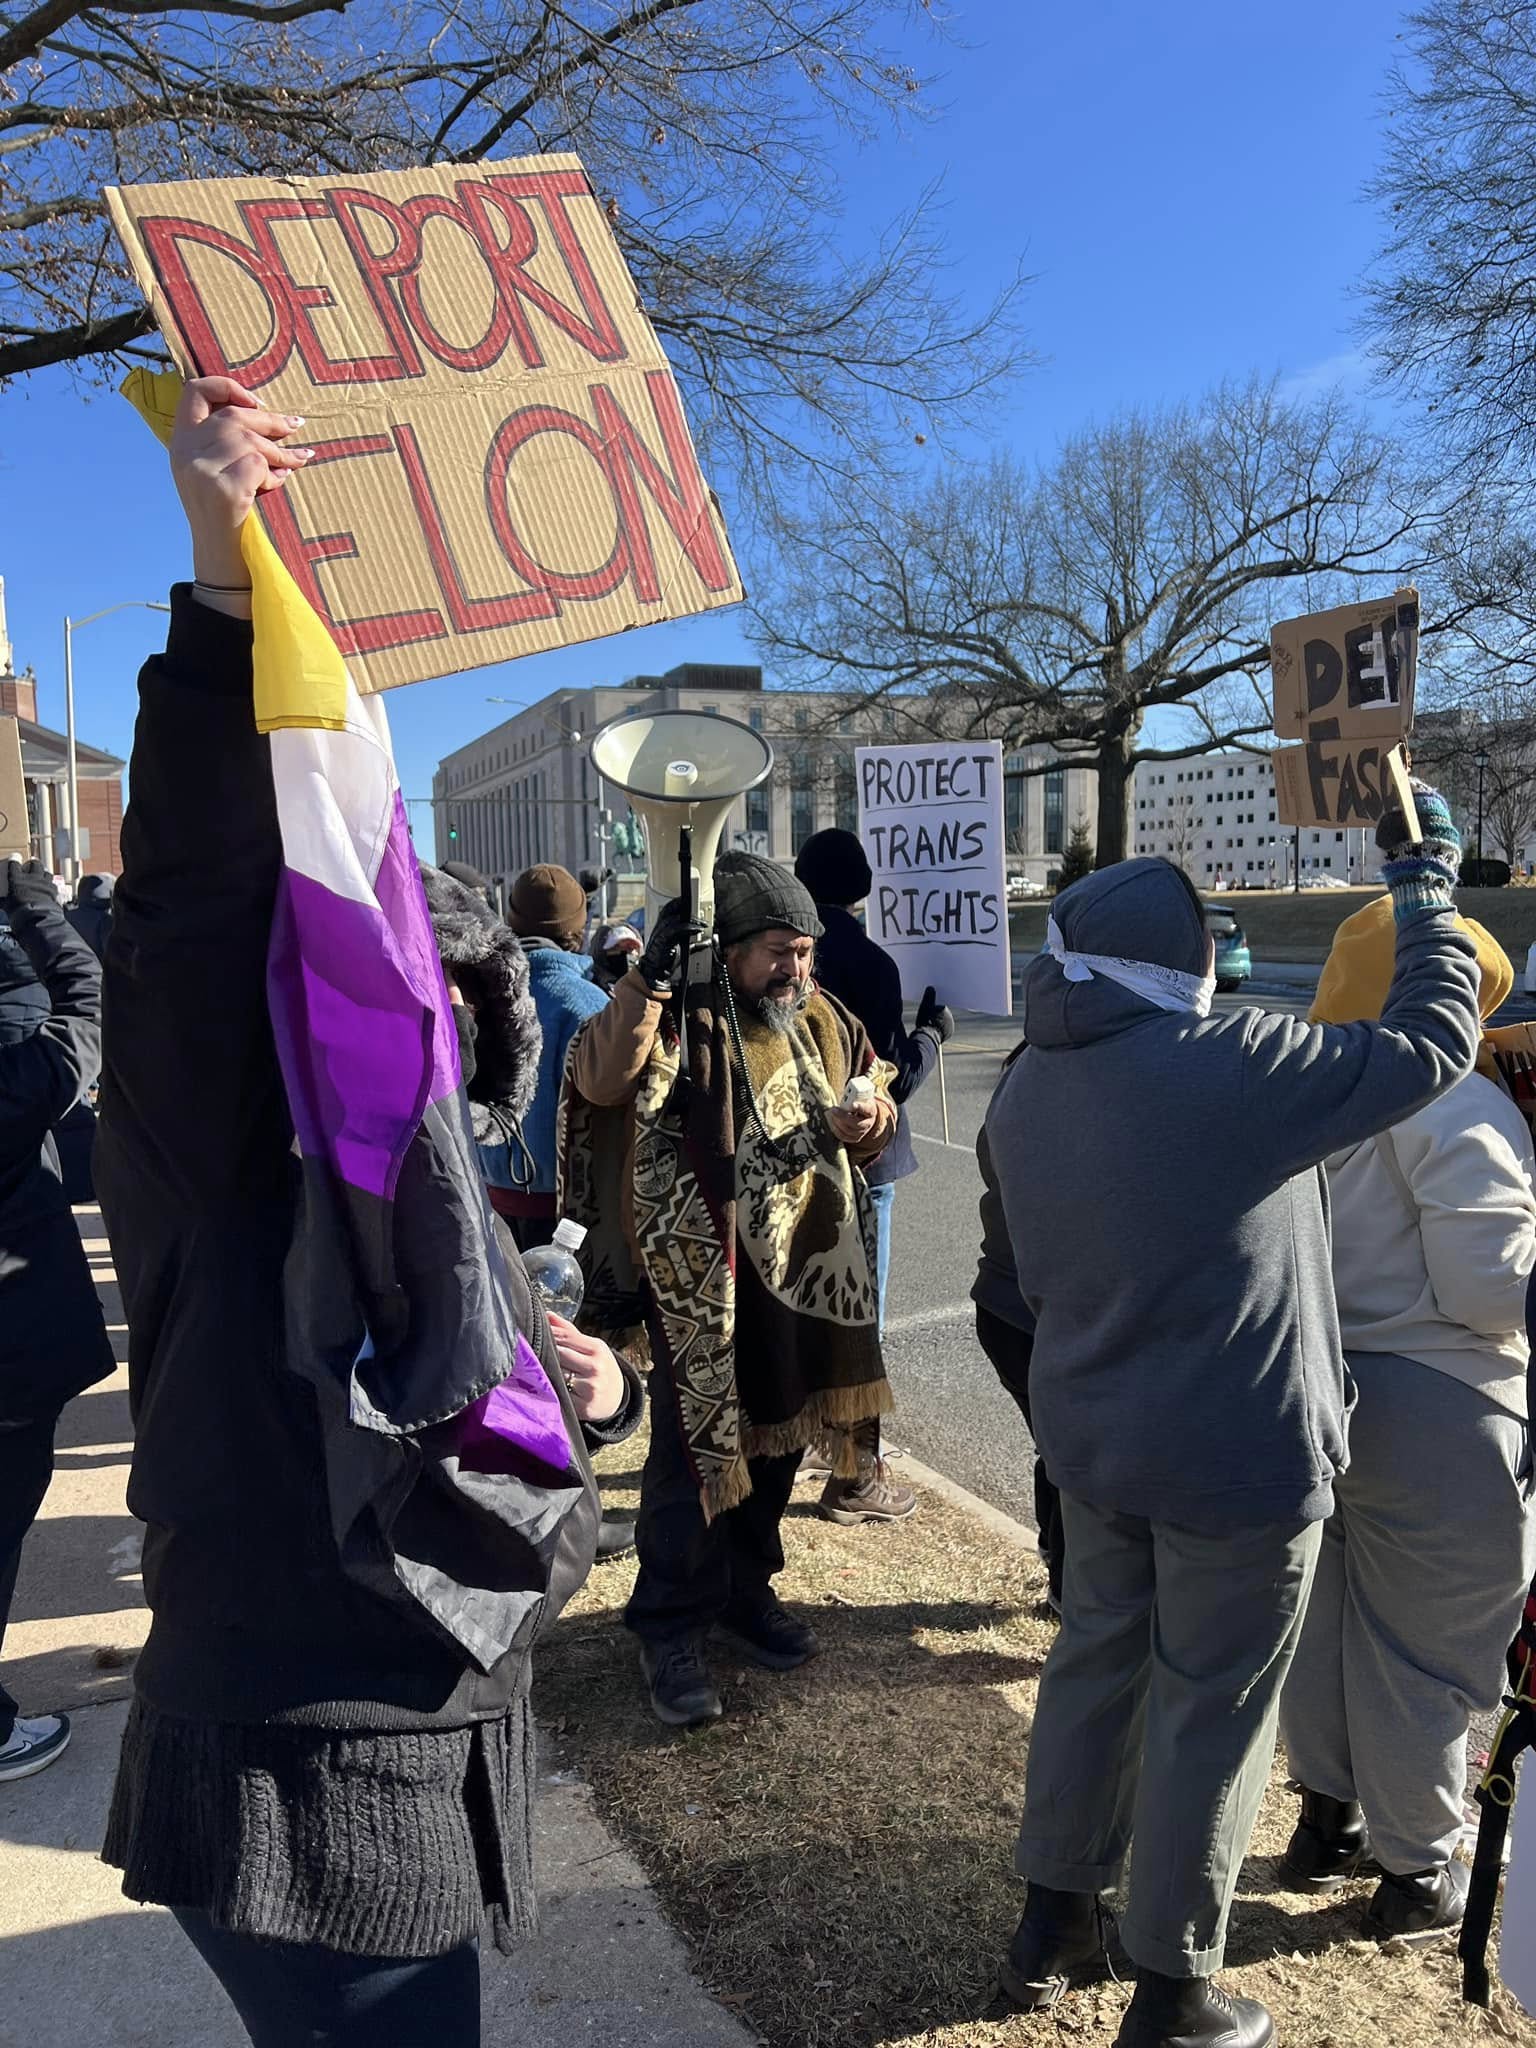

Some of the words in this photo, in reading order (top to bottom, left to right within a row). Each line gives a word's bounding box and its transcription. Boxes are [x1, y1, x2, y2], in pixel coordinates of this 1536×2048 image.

[138, 171, 628, 390] DEPORT
[257, 372, 733, 655] ELON
[862, 756, 995, 808] PROTECT
[869, 820, 988, 868] TRANS
[879, 886, 999, 938] RIGHTS
